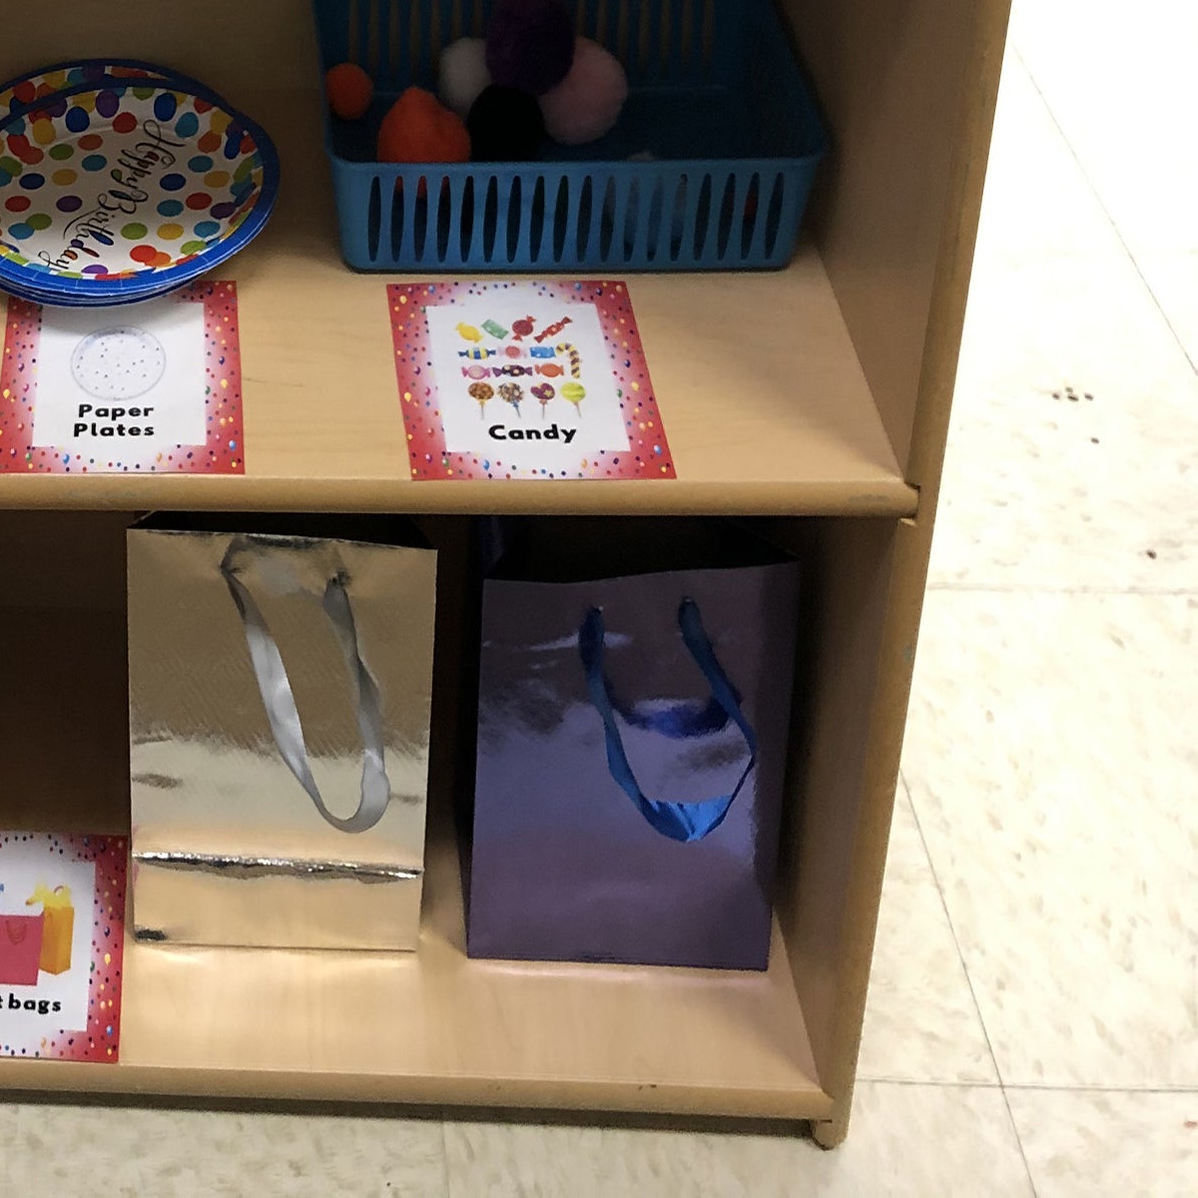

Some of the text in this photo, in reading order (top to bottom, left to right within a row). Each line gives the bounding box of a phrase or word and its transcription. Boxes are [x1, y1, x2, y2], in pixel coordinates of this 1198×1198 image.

[110, 119, 187, 191] Happy
[38, 187, 149, 271] Birthday
[78, 404, 155, 421] Paper
[73, 423, 155, 438] Plates
[488, 424, 577, 444] Candy
